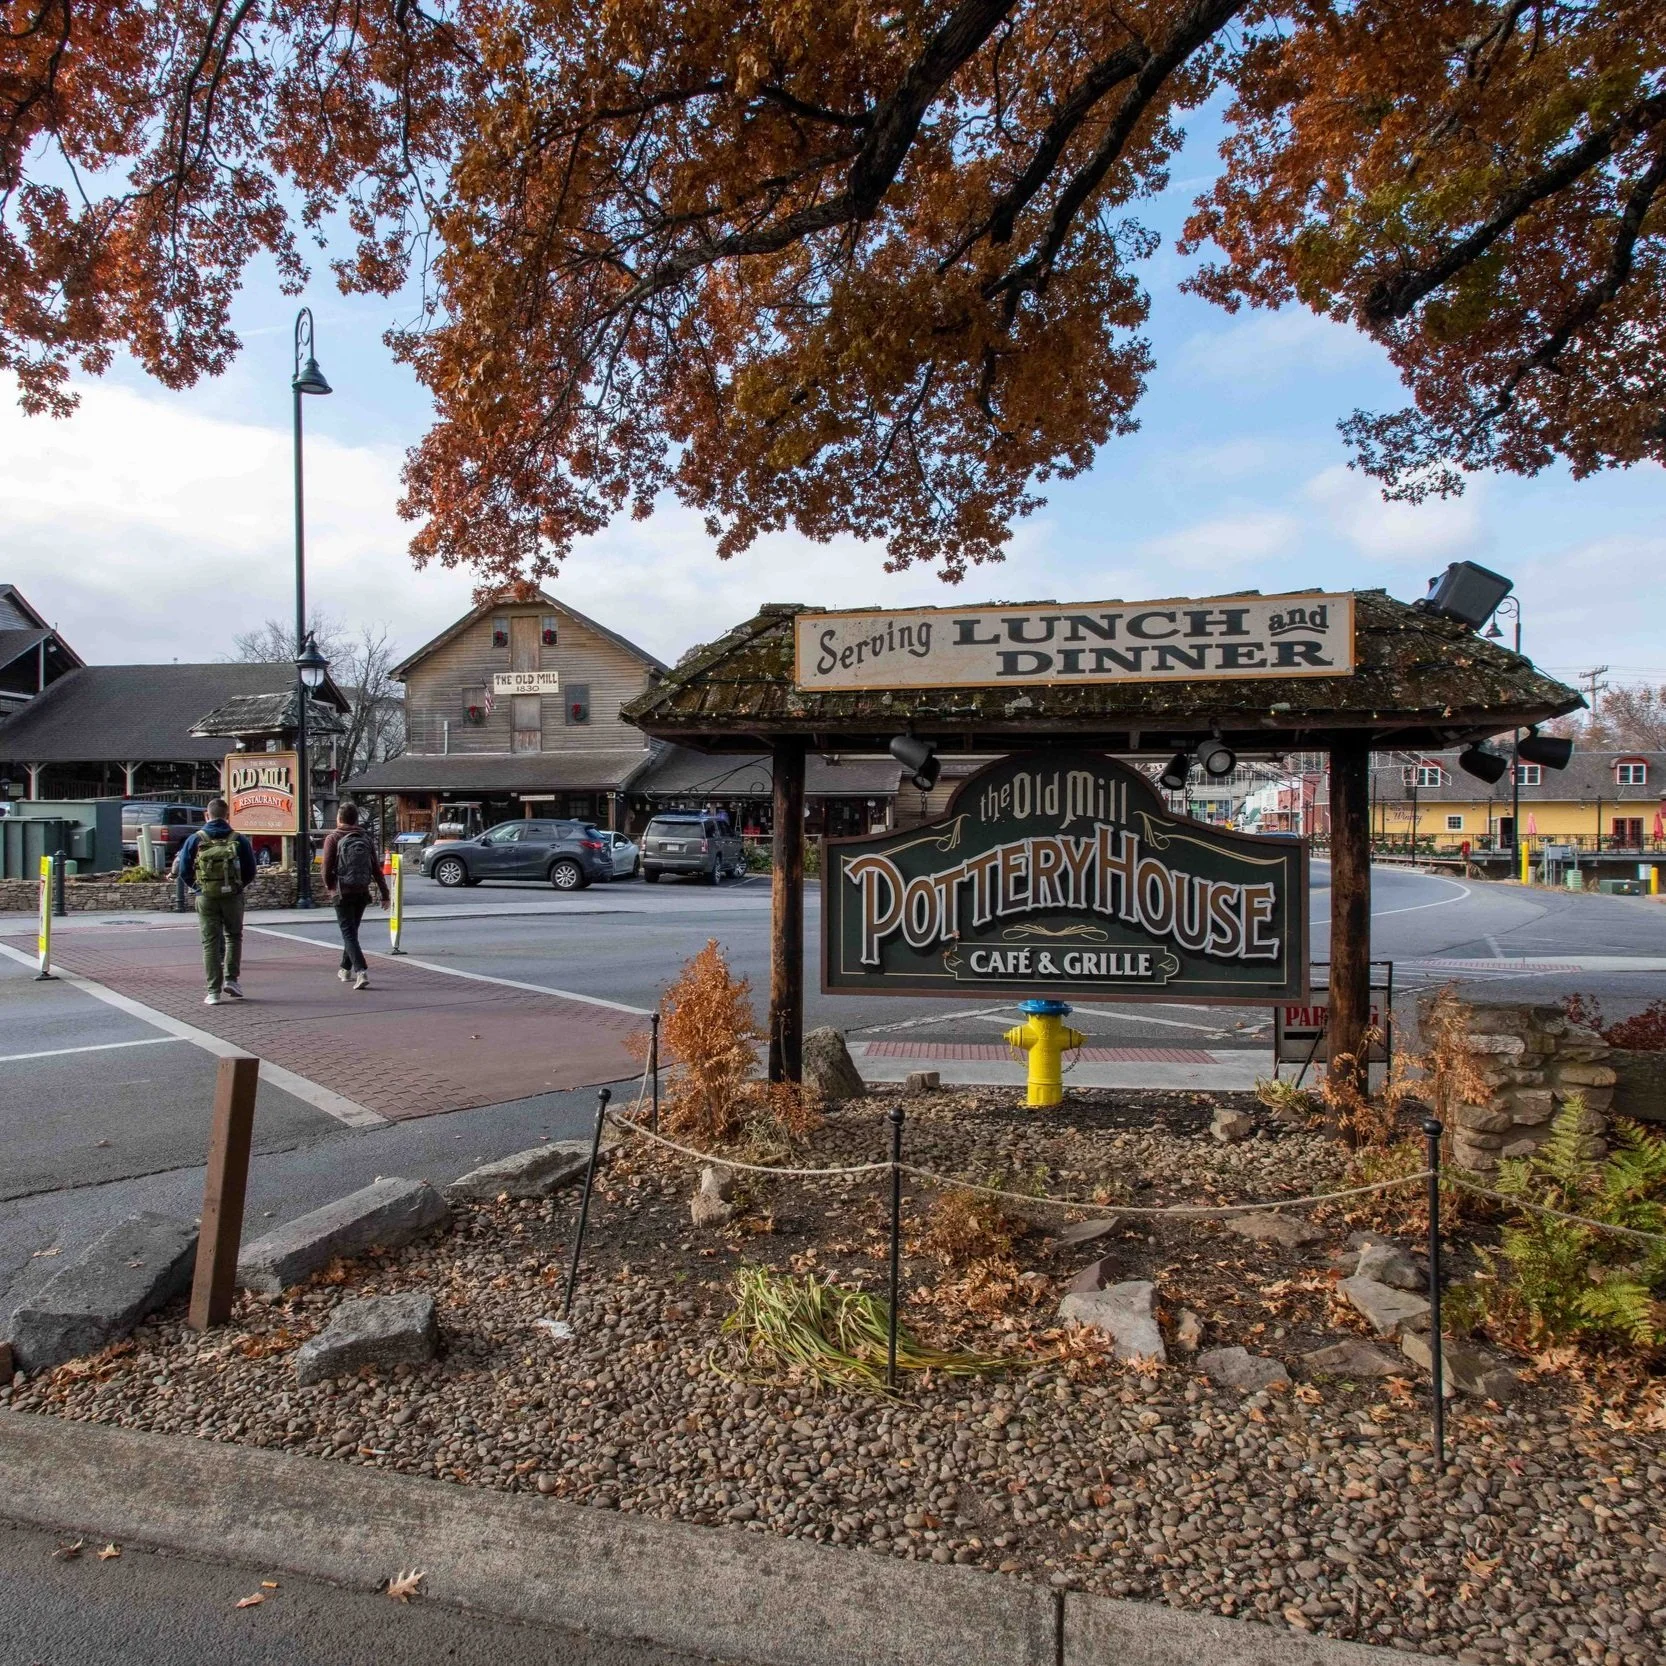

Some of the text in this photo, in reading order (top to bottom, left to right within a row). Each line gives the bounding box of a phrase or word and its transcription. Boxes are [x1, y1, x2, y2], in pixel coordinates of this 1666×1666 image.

[816, 604, 1330, 675] Serving LUNCH and
[996, 640, 1334, 676] DINNER
[495, 673, 557, 686] THE OLD MILL
[231, 767, 291, 793] OLD MILL
[239, 795, 282, 807] RESTAURANT
[980, 770, 1127, 829] the Old Mill
[969, 947, 1153, 976] CAFÉ & GRILLE
[1285, 1005, 1380, 1028] PARG
